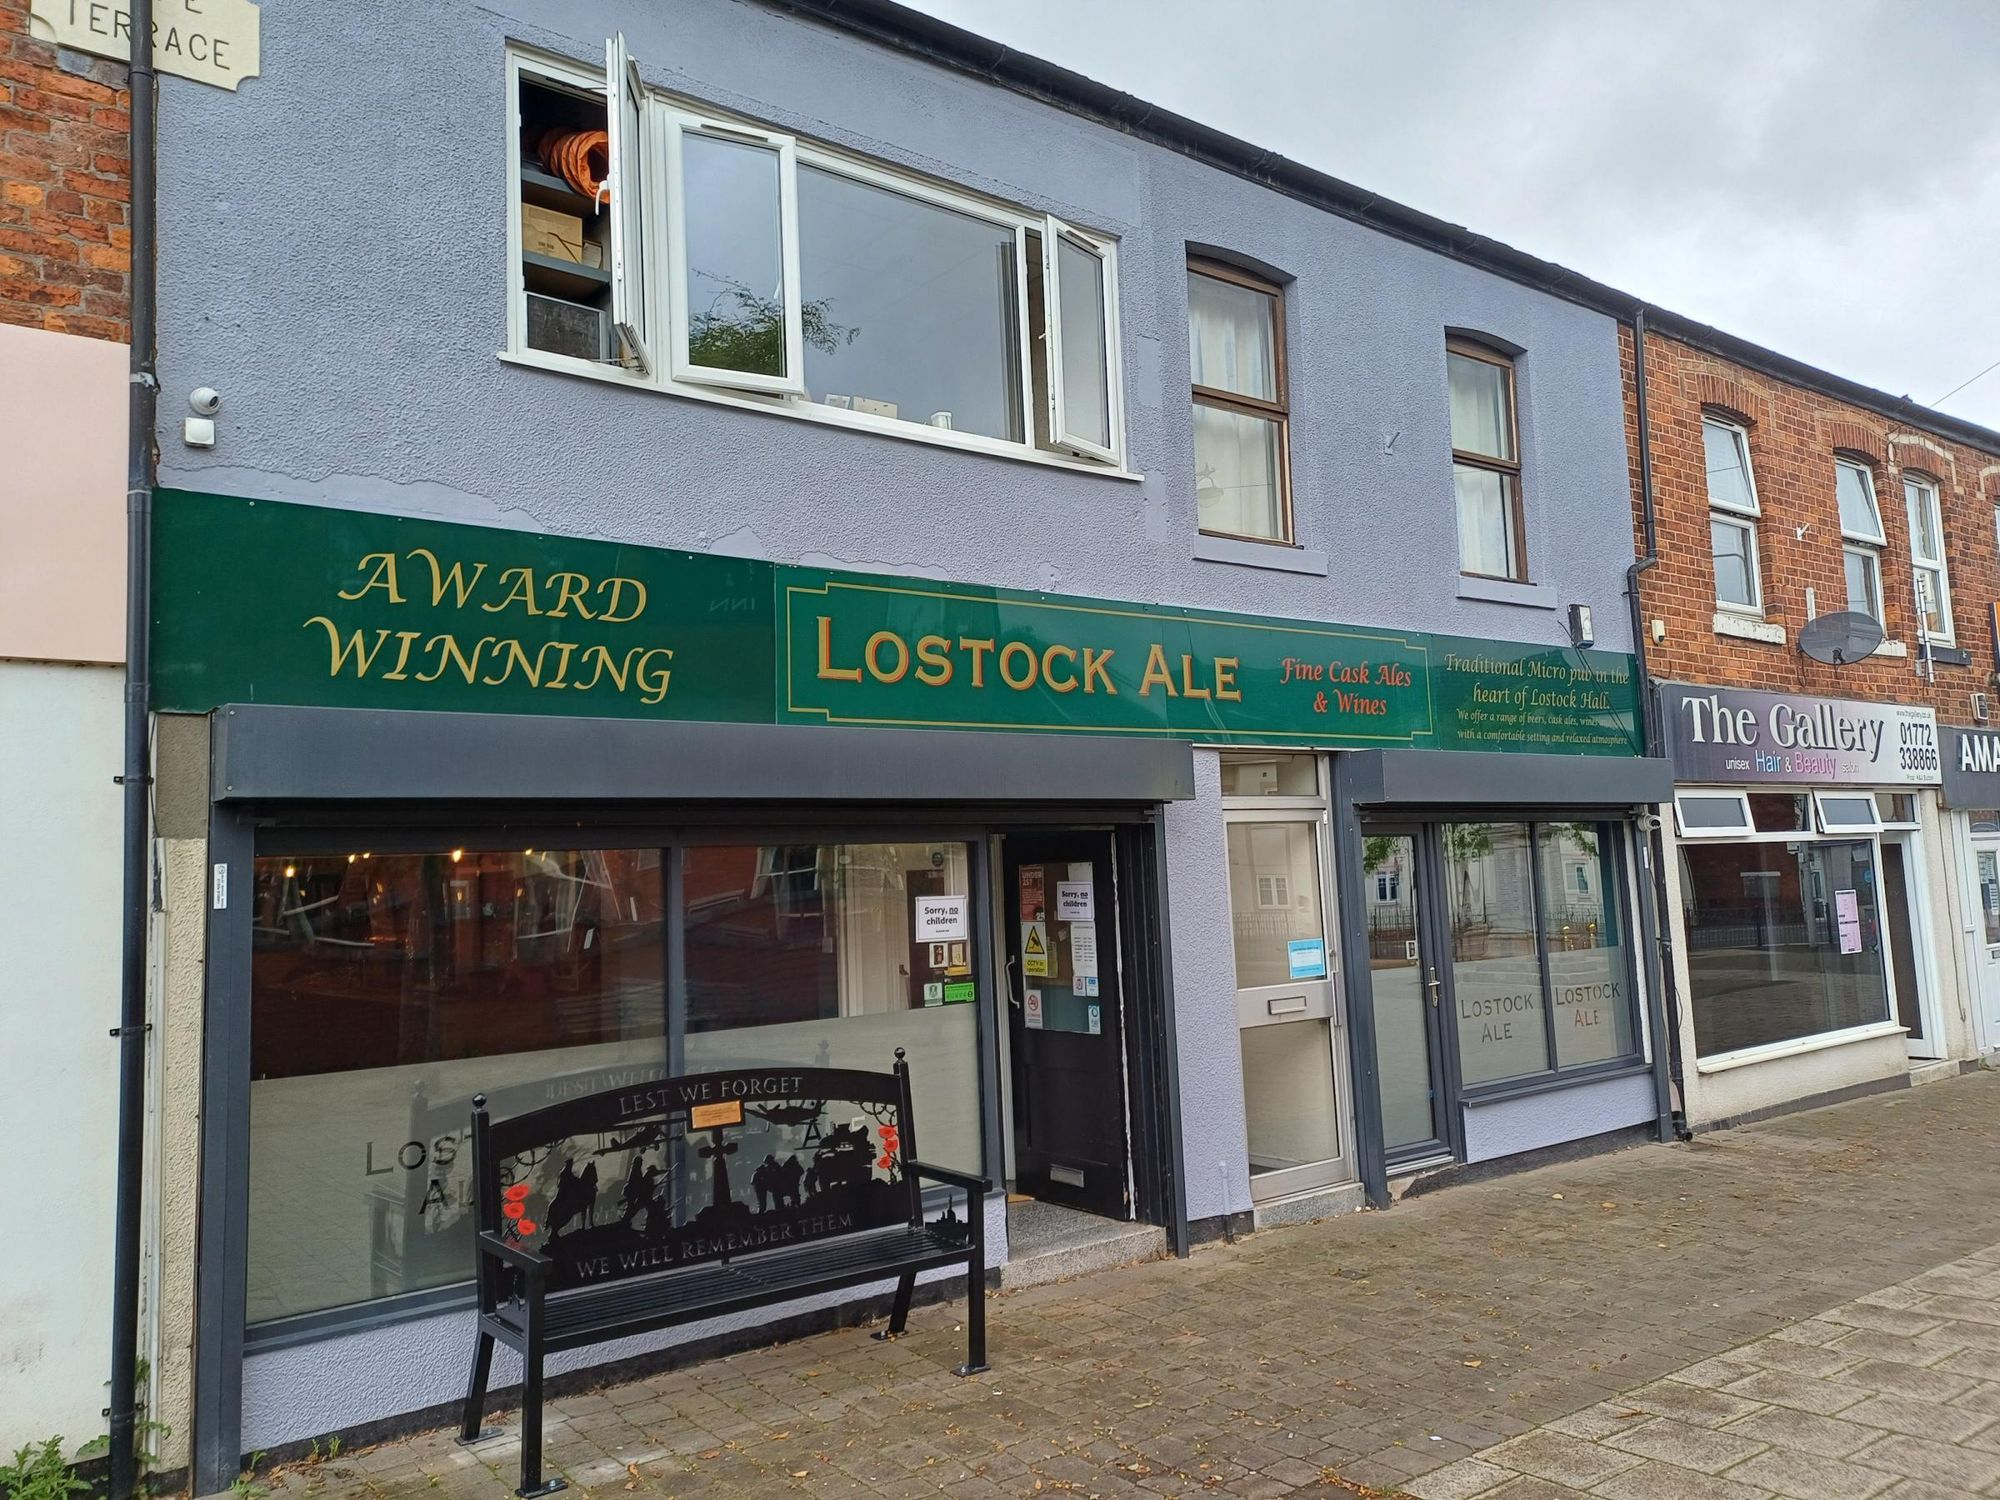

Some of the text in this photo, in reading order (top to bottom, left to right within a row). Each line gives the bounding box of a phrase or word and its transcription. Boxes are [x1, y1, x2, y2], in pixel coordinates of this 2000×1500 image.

[337, 548, 647, 623] AWARD
[302, 615, 674, 705] WINNING
[816, 615, 1242, 703] LOSTOCK ALE
[1280, 657, 1412, 687] Fine Cask Ales
[1444, 653, 1525, 677] Traditional
[1527, 660, 1566, 680] Micro
[1567, 664, 1592, 687] pub
[1611, 665, 1629, 685] the
[1313, 689, 1387, 716] & Wines
[1473, 682, 1610, 710] heart of Lostock Hall.
[1456, 708, 1469, 720] We
[1470, 711, 1487, 724] offer
[1489, 713, 1495, 721] a
[1496, 713, 1517, 725] range
[1518, 711, 1527, 725] of
[1527, 712, 1547, 725] beers,
[1548, 713, 1563, 724] cask
[1564, 713, 1579, 726] ales,
[1681, 694, 1884, 763] The Gallery
[1457, 729, 1475, 739] with
[1476, 731, 1482, 739] a
[1483, 729, 1527, 743] comfortable
[1527, 731, 1550, 745] setting
[1551, 732, 1565, 743] and
[1565, 732, 1590, 744] relaxed
[1900, 722, 1932, 746] 01772
[1725, 757, 1750, 770] unisex
[1755, 750, 1782, 773] Hair
[1784, 756, 1793, 773] &
[1795, 751, 1836, 779] Beauty
[1899, 747, 1937, 771] 338866
[1061, 890, 1089, 899] Sorry, no
[1062, 900, 1088, 908] children
[924, 906, 959, 916] Sorry, no
[926, 916, 958, 925] children
[1461, 992, 1534, 1019] LOSTOCK
[1555, 982, 1621, 1006] LOSTOCK
[1574, 1008, 1599, 1028] ALE
[1481, 1022, 1513, 1043] ALE
[619, 1089, 669, 1115] LEST
[679, 1083, 713, 1102] WE
[721, 1076, 803, 1097] FORGET
[576, 1213, 853, 1279] WE WILL REMEMBER THEM
